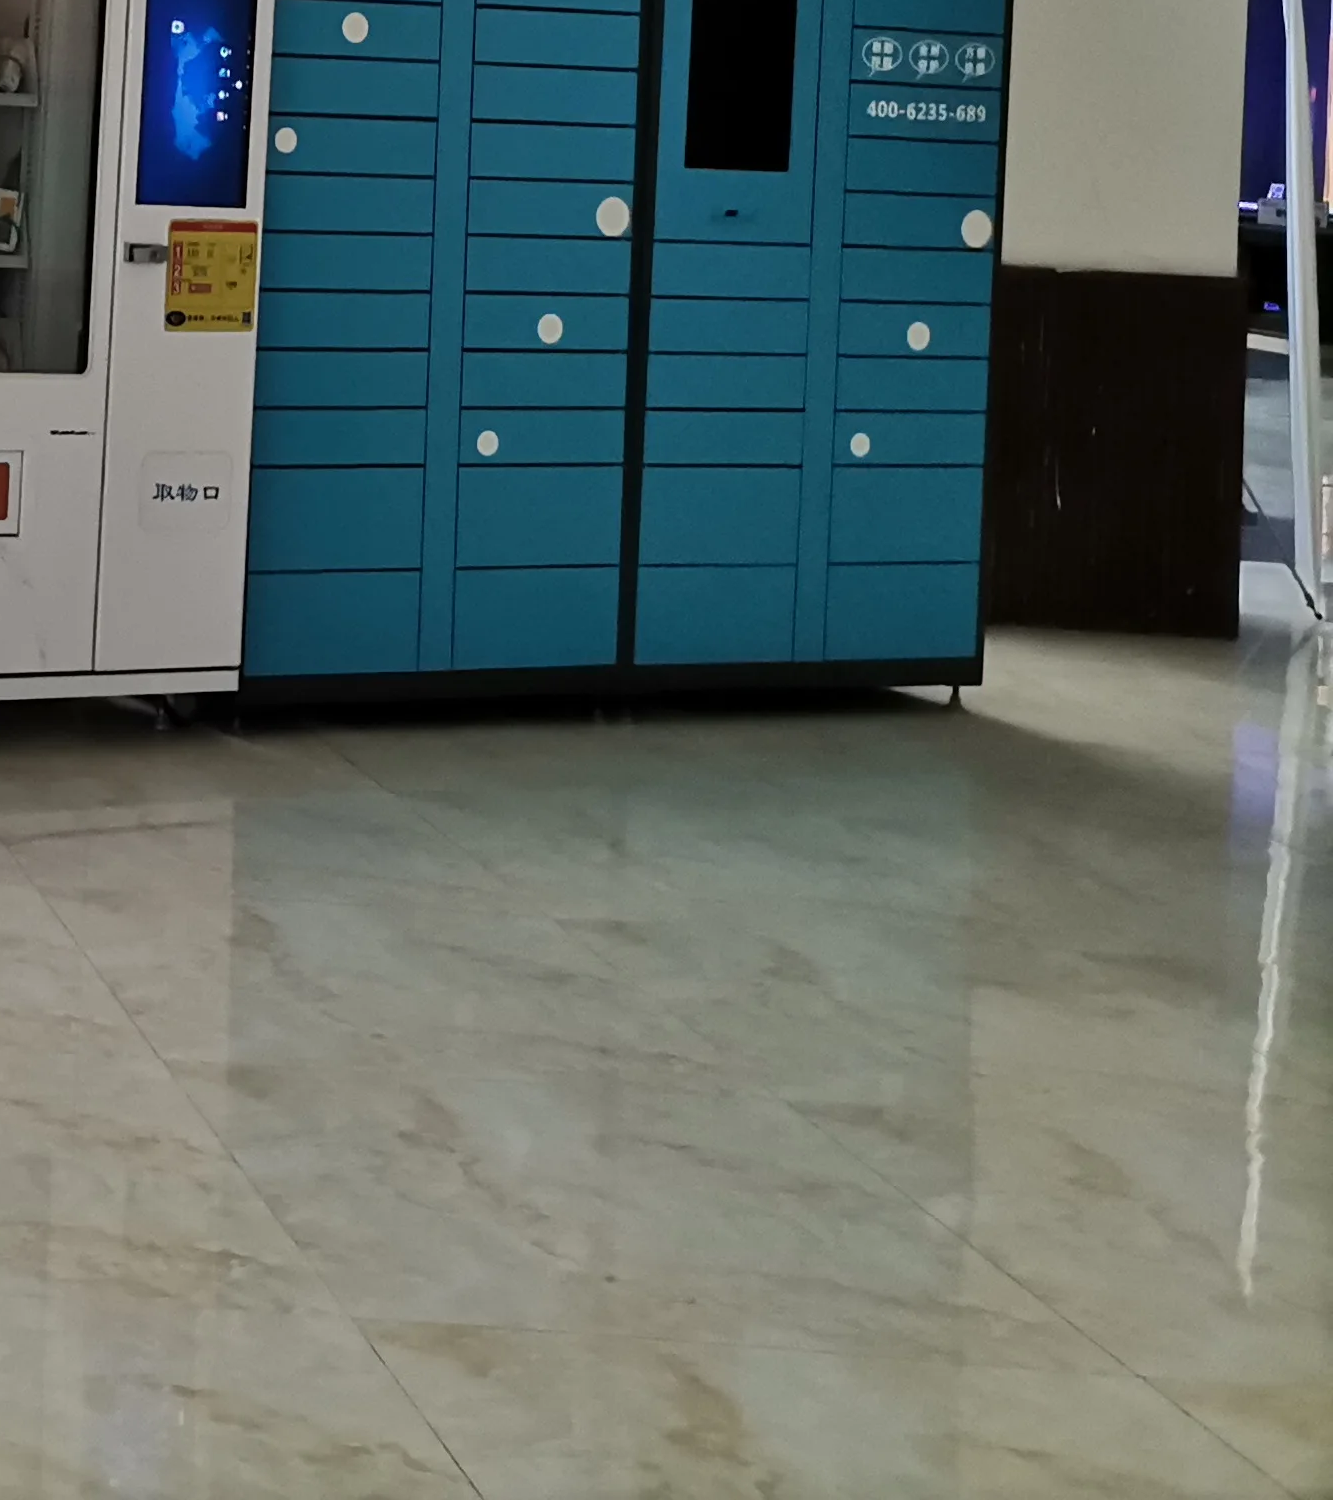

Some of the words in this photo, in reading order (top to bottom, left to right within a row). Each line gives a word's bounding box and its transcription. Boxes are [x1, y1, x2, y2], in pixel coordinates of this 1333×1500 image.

[867, 100, 987, 123] 400-6235-689
[152, 482, 220, 503] 取物口
